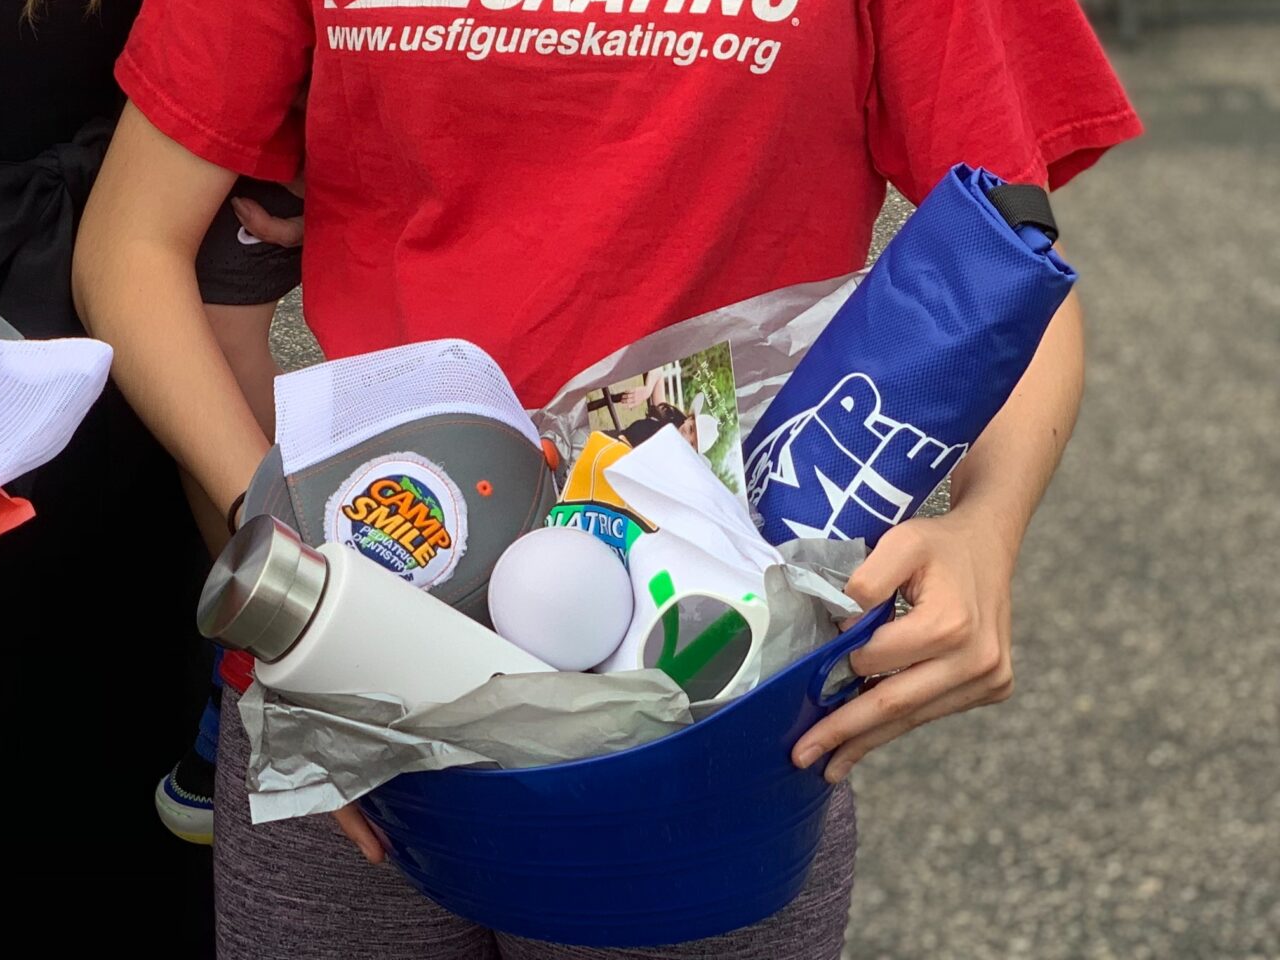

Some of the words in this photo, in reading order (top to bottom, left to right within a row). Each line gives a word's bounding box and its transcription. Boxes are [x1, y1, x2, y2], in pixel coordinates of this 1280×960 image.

[326, 18, 782, 75] www.usfigureskating.org
[341, 495, 437, 569] SMILE
[368, 477, 452, 550] CAMP
[353, 532, 410, 576] DENTISTRY
[359, 525, 418, 566] PEDIATRIC
